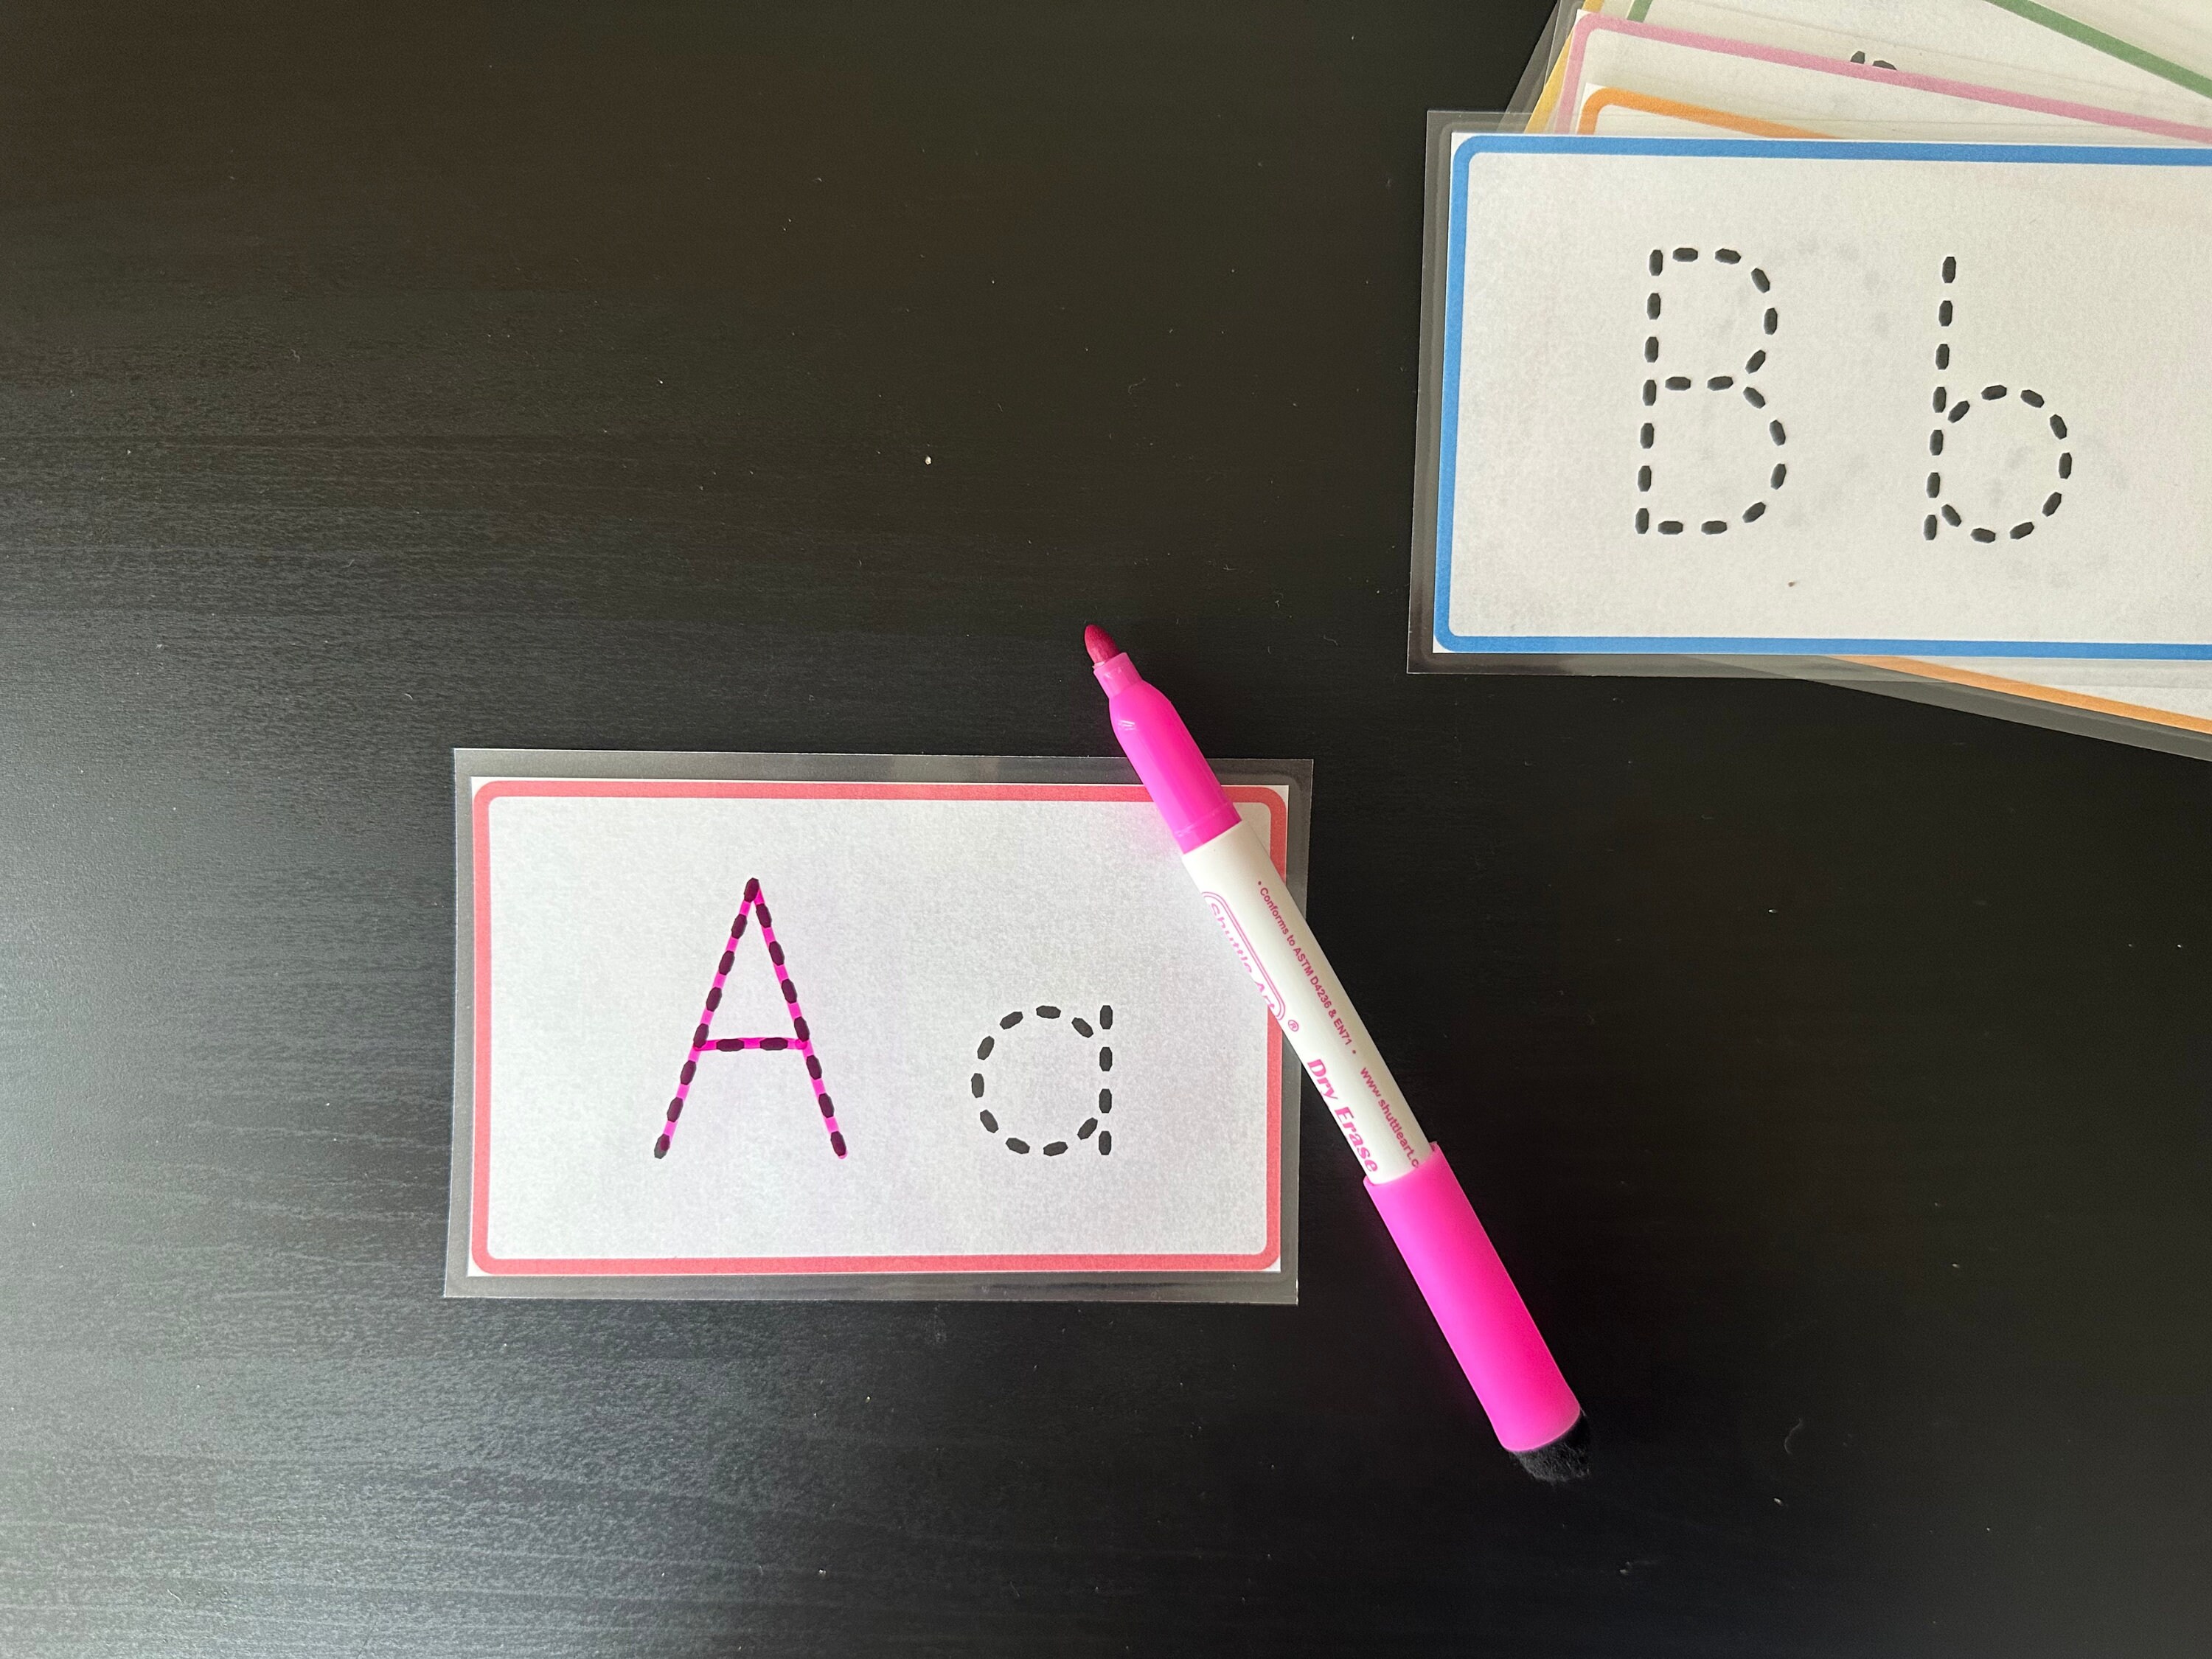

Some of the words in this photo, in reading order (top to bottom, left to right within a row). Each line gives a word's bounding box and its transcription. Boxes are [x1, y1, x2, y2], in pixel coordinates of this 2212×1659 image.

[1636, 247, 1788, 535] B
[1925, 255, 2073, 543] b
[653, 877, 847, 1160] A
[970, 1005, 1113, 1157] a
[1260, 887, 1289, 935] Conforms
[1287, 934, 1295, 947] to
[1293, 947, 1314, 976] ASTM
[1310, 975, 1332, 1009] D4236
[1328, 1009, 1337, 1019] &
[1334, 1018, 1352, 1046] EN71
[1307, 1059, 1338, 1099] Dry
[1335, 1107, 1378, 1172] Erase
